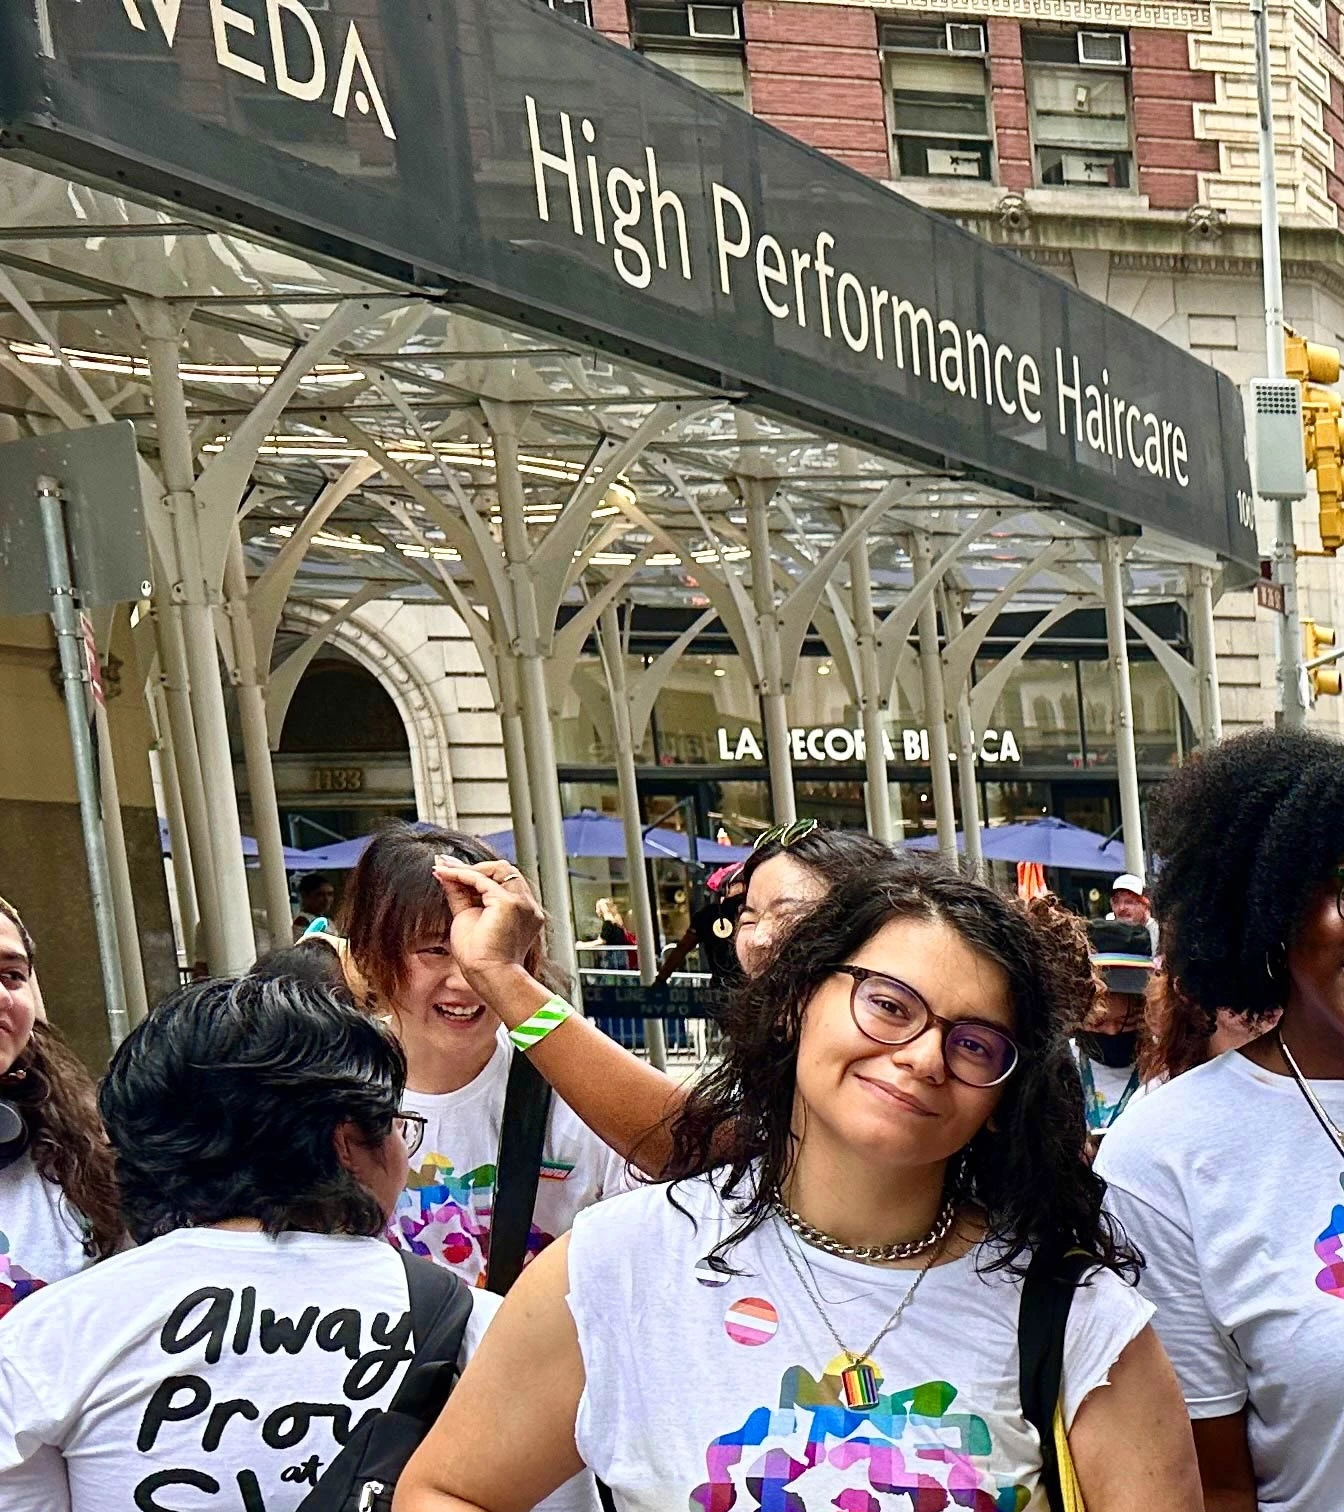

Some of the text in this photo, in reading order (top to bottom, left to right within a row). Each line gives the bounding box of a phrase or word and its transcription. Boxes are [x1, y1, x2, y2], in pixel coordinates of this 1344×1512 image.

[122, 0, 397, 141] EDA
[526, 95, 1189, 486] High Performance Haircare
[718, 727, 1020, 762] LA ECO BICA
[161, 1286, 414, 1400] Alway
[137, 1375, 351, 1452] Pro
[281, 1455, 324, 1486] at
